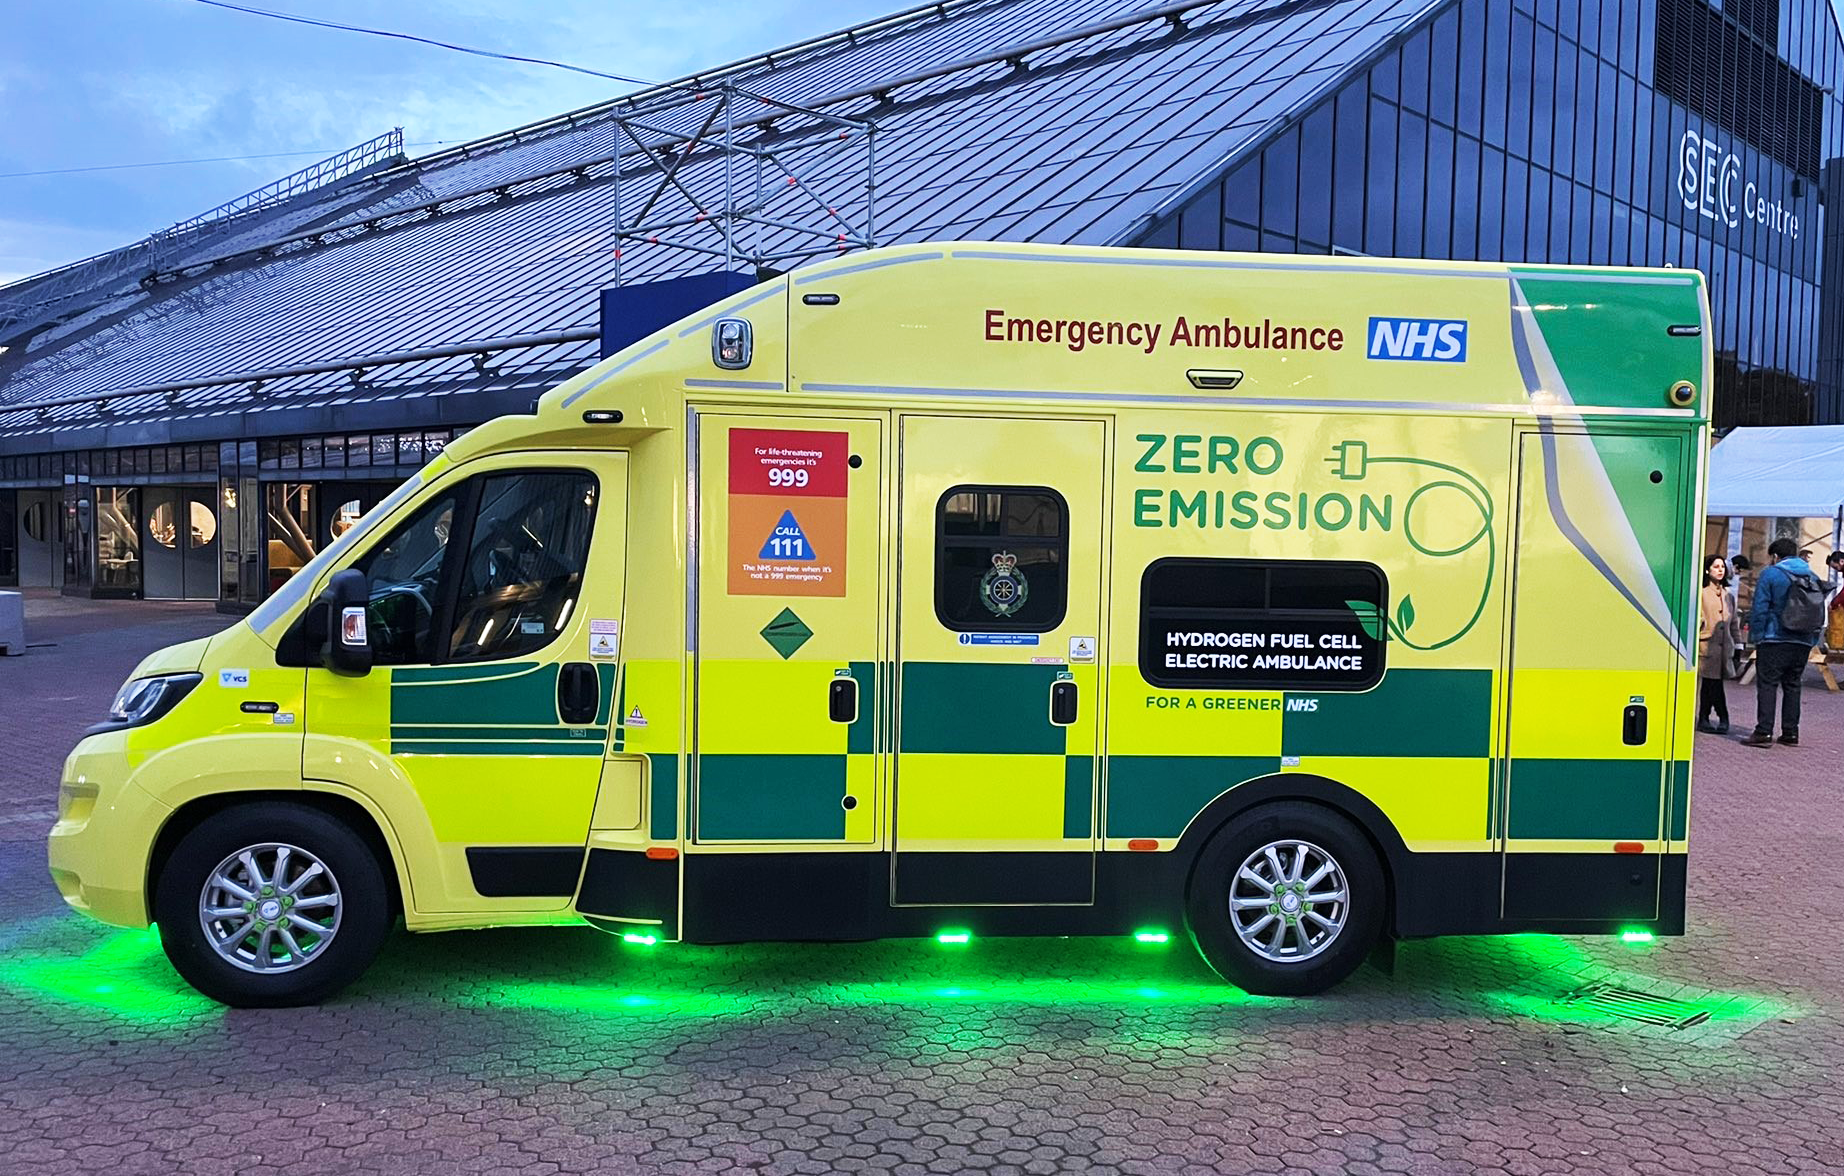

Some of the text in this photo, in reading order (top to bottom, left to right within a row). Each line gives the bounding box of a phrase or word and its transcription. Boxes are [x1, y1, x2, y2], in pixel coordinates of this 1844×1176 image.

[1744, 181, 1799, 240] Centre
[985, 309, 1464, 360] Emergency Ambulance NHS
[754, 447, 823, 459] For life-threatening
[761, 457, 817, 466] emergencies it's
[1134, 433, 1284, 475] ZERO
[768, 468, 809, 487] 999
[1134, 489, 1393, 532] EMISSION
[775, 526, 801, 536] CALL
[770, 538, 803, 557] 111
[757, 564, 771, 572] NHS
[773, 564, 800, 573] number
[771, 572, 784, 580] 999
[786, 573, 824, 582] emergency
[1166, 632, 1362, 650] HYDROGEN FUEL CELL
[1165, 654, 1362, 670] ELECTRIC AMBULANCE
[1146, 696, 1319, 712] FOR A GREENER NHS
